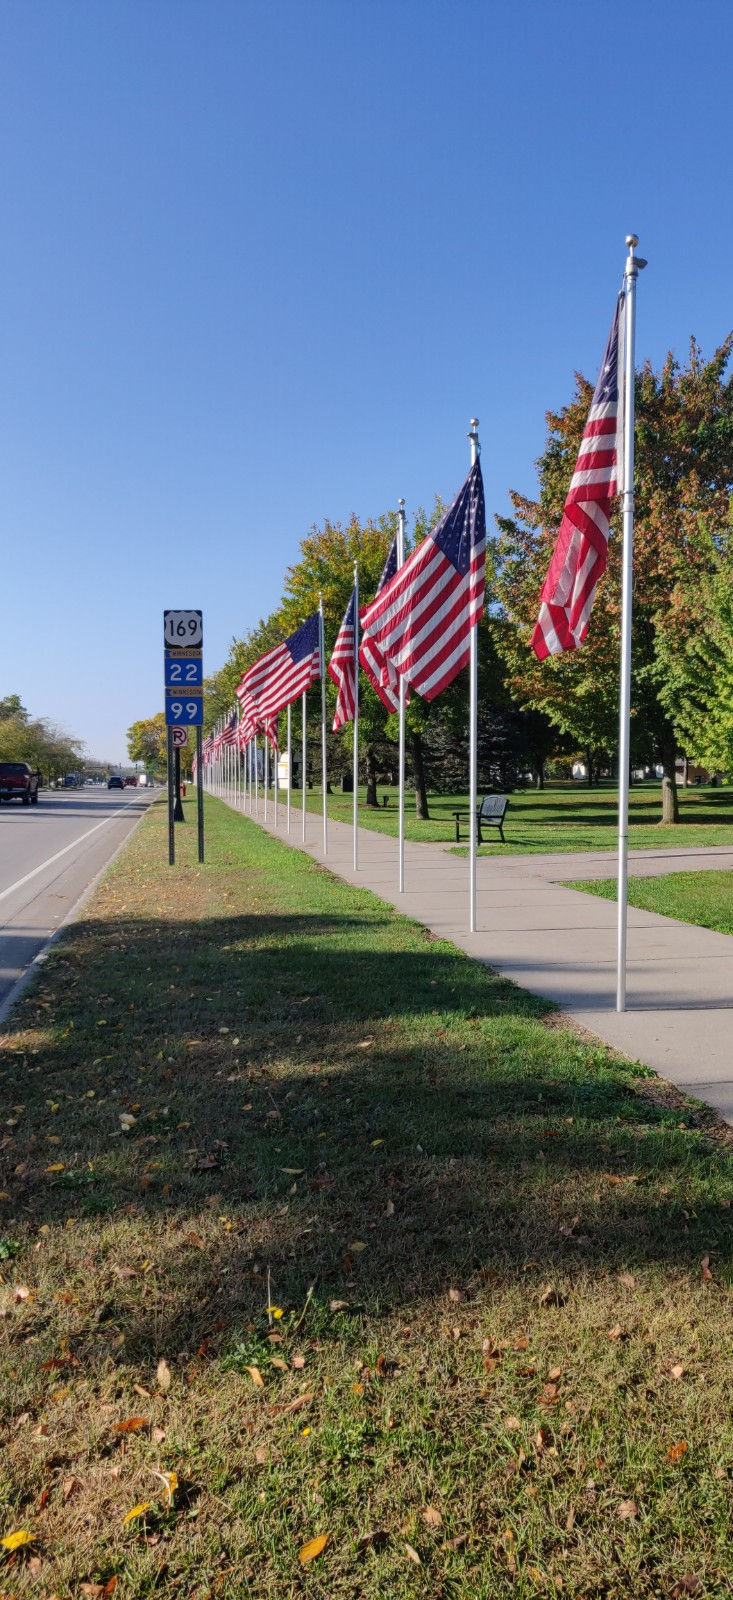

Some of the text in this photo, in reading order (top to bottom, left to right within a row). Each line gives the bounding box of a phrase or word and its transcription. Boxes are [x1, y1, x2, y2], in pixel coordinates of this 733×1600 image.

[169, 619, 197, 637] 169
[170, 664, 198, 681] 22
[171, 702, 198, 719] 99
